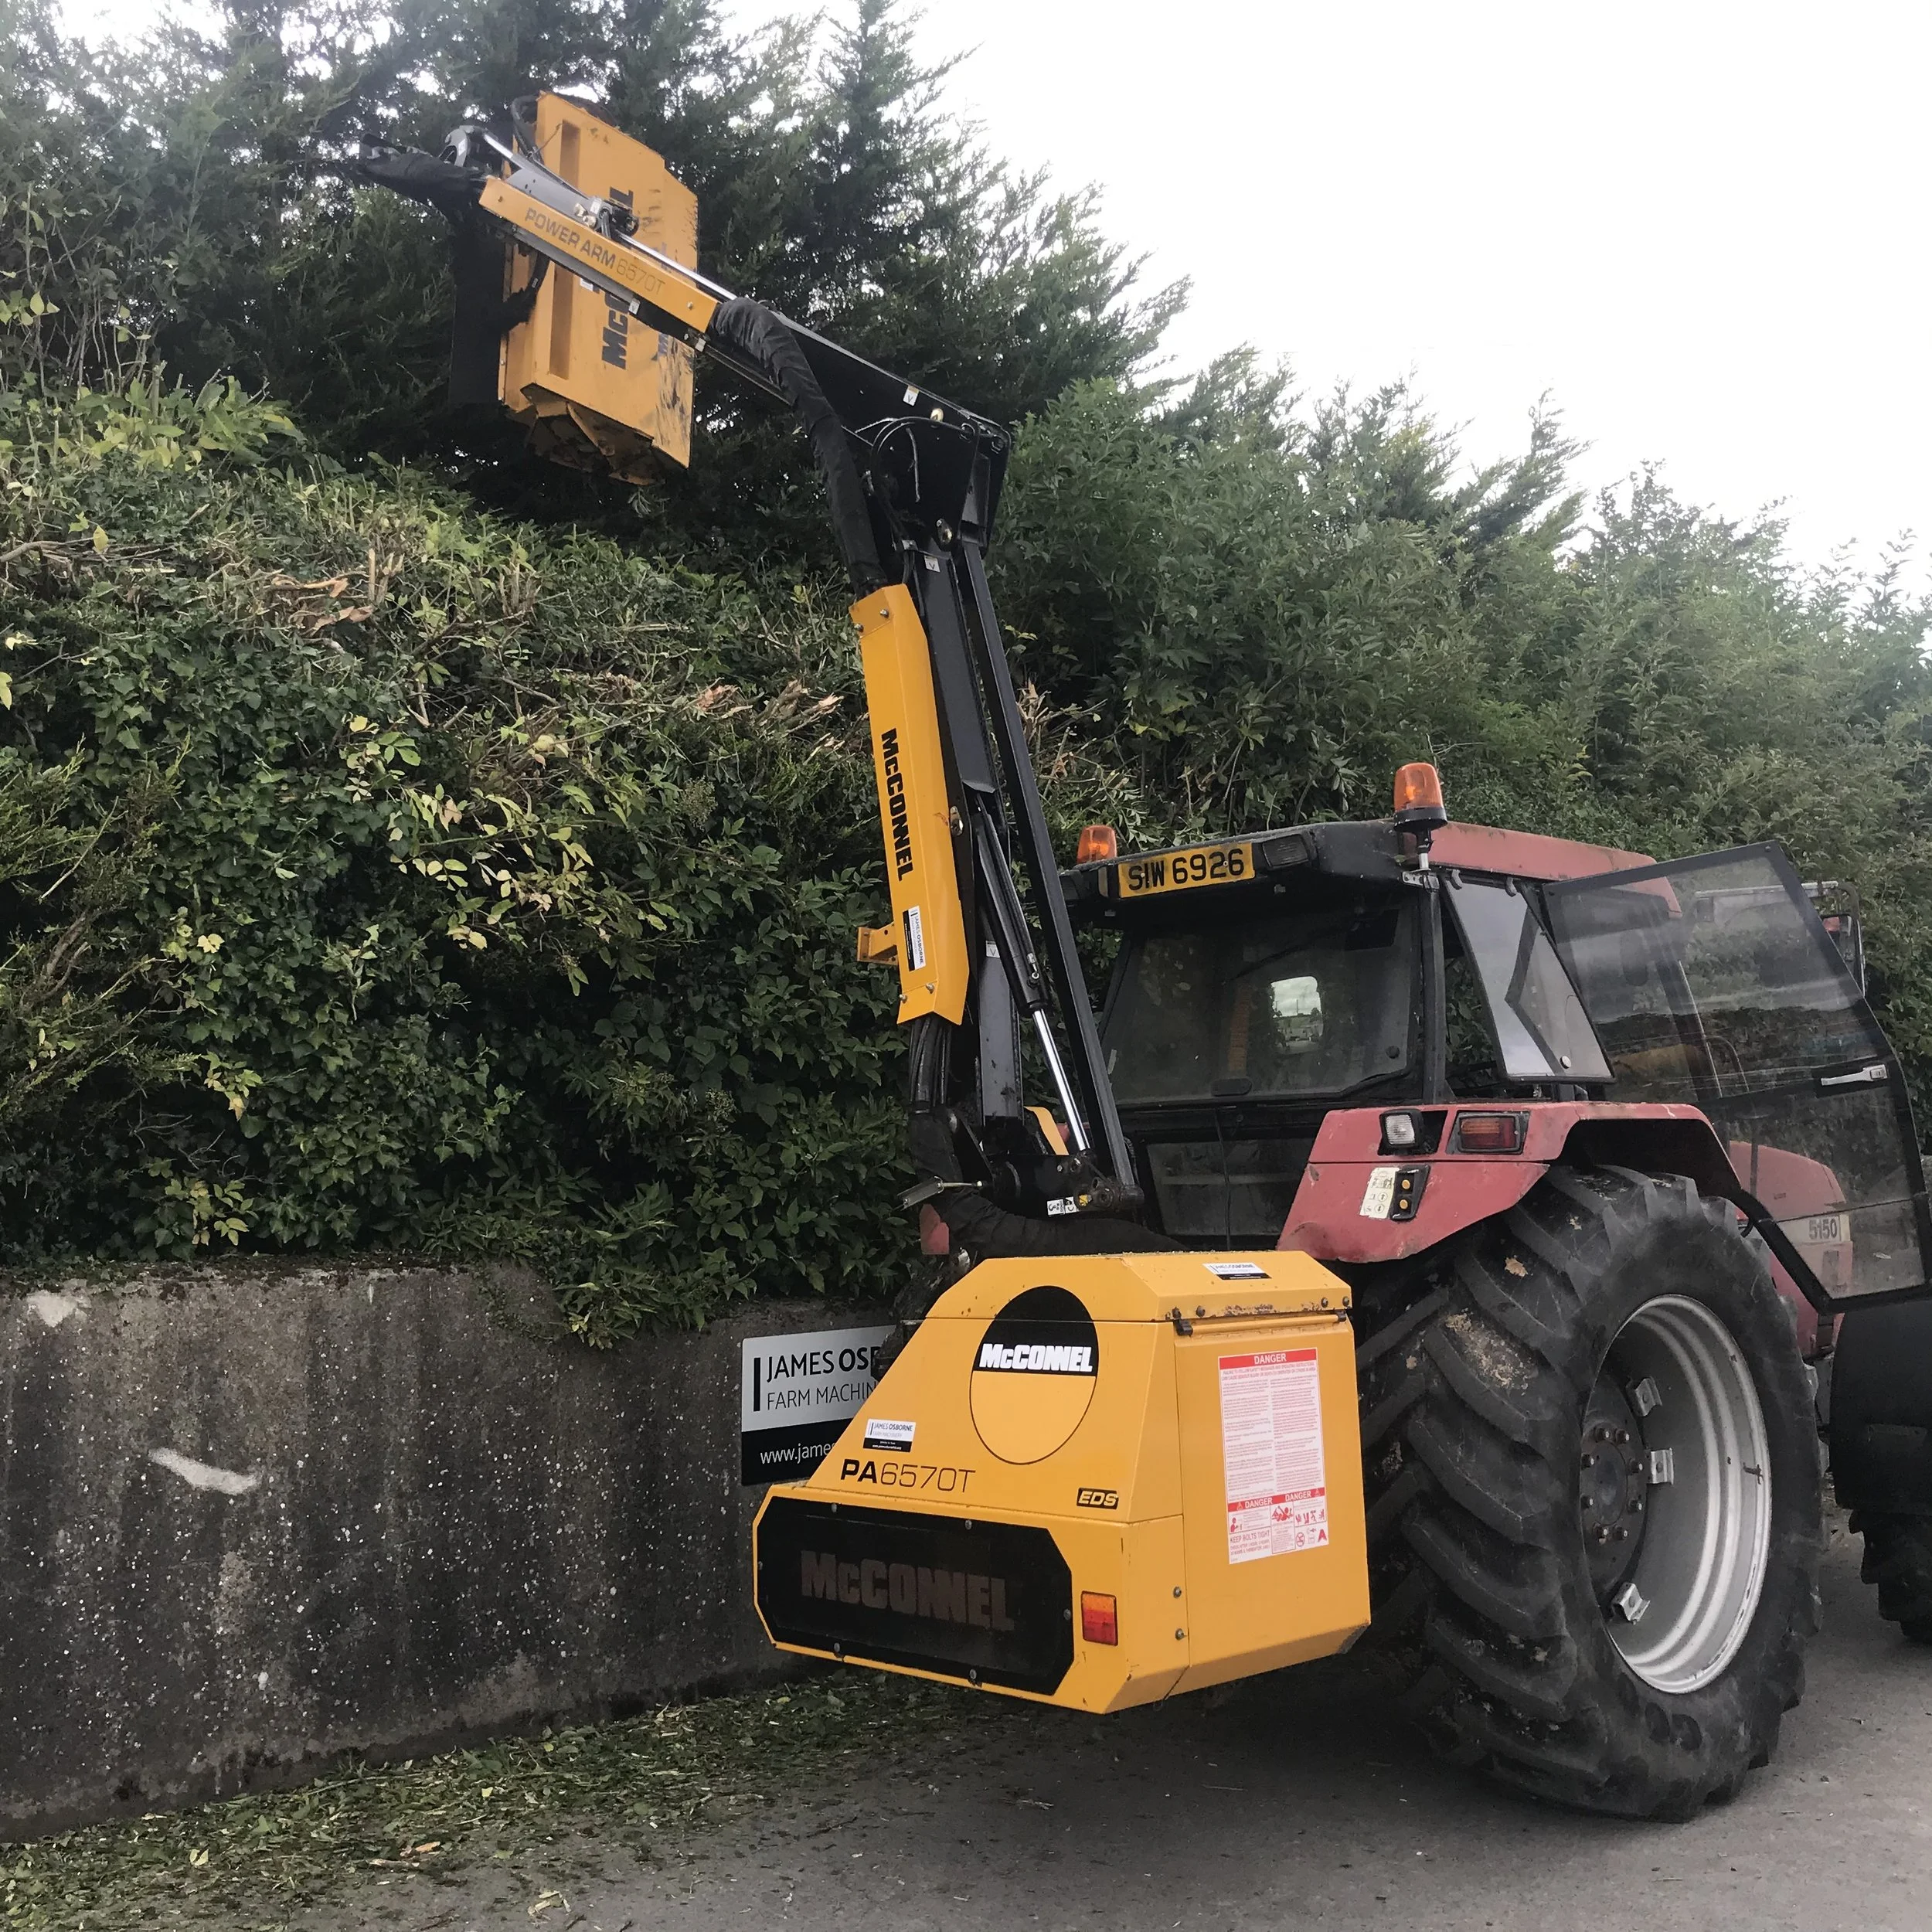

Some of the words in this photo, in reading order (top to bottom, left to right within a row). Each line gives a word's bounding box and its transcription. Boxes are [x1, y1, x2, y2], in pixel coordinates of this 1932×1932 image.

[525, 207, 581, 249] POWER
[580, 240, 617, 270] ARM
[616, 258, 666, 295] 6570T
[1172, 849, 1244, 884] 6926
[1809, 1219, 1838, 1240] 5150
[767, 1350, 835, 1383] JAMES
[1253, 1352, 1287, 1365] DANGER
[767, 1389, 811, 1410] FARM
[840, 1458, 976, 1492] PA6570T
[1078, 1490, 1118, 1507] EDS
[1244, 1497, 1273, 1509] DANGER
[1284, 1490, 1311, 1502] DANGER
